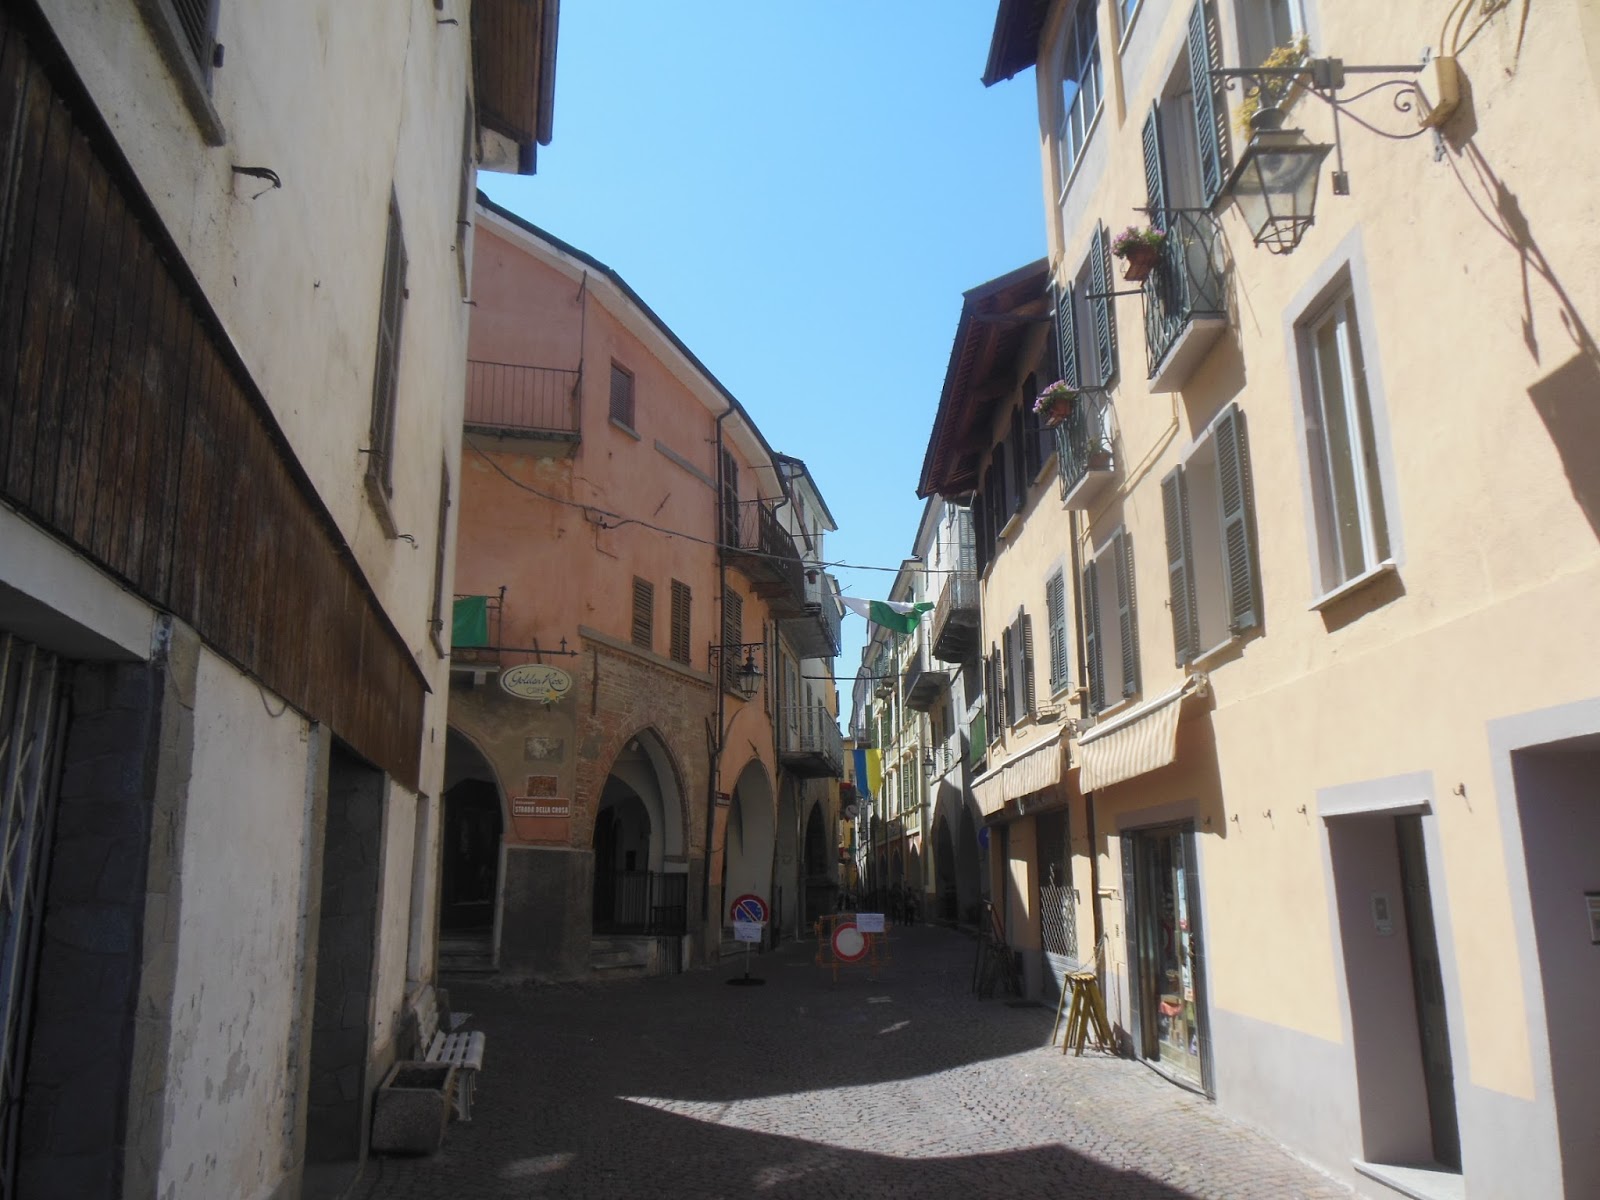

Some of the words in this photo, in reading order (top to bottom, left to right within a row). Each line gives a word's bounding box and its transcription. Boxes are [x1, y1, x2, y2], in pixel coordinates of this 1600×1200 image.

[509, 670, 543, 687] Golden
[542, 672, 565, 687] Rose
[535, 806, 551, 814] DELLA
